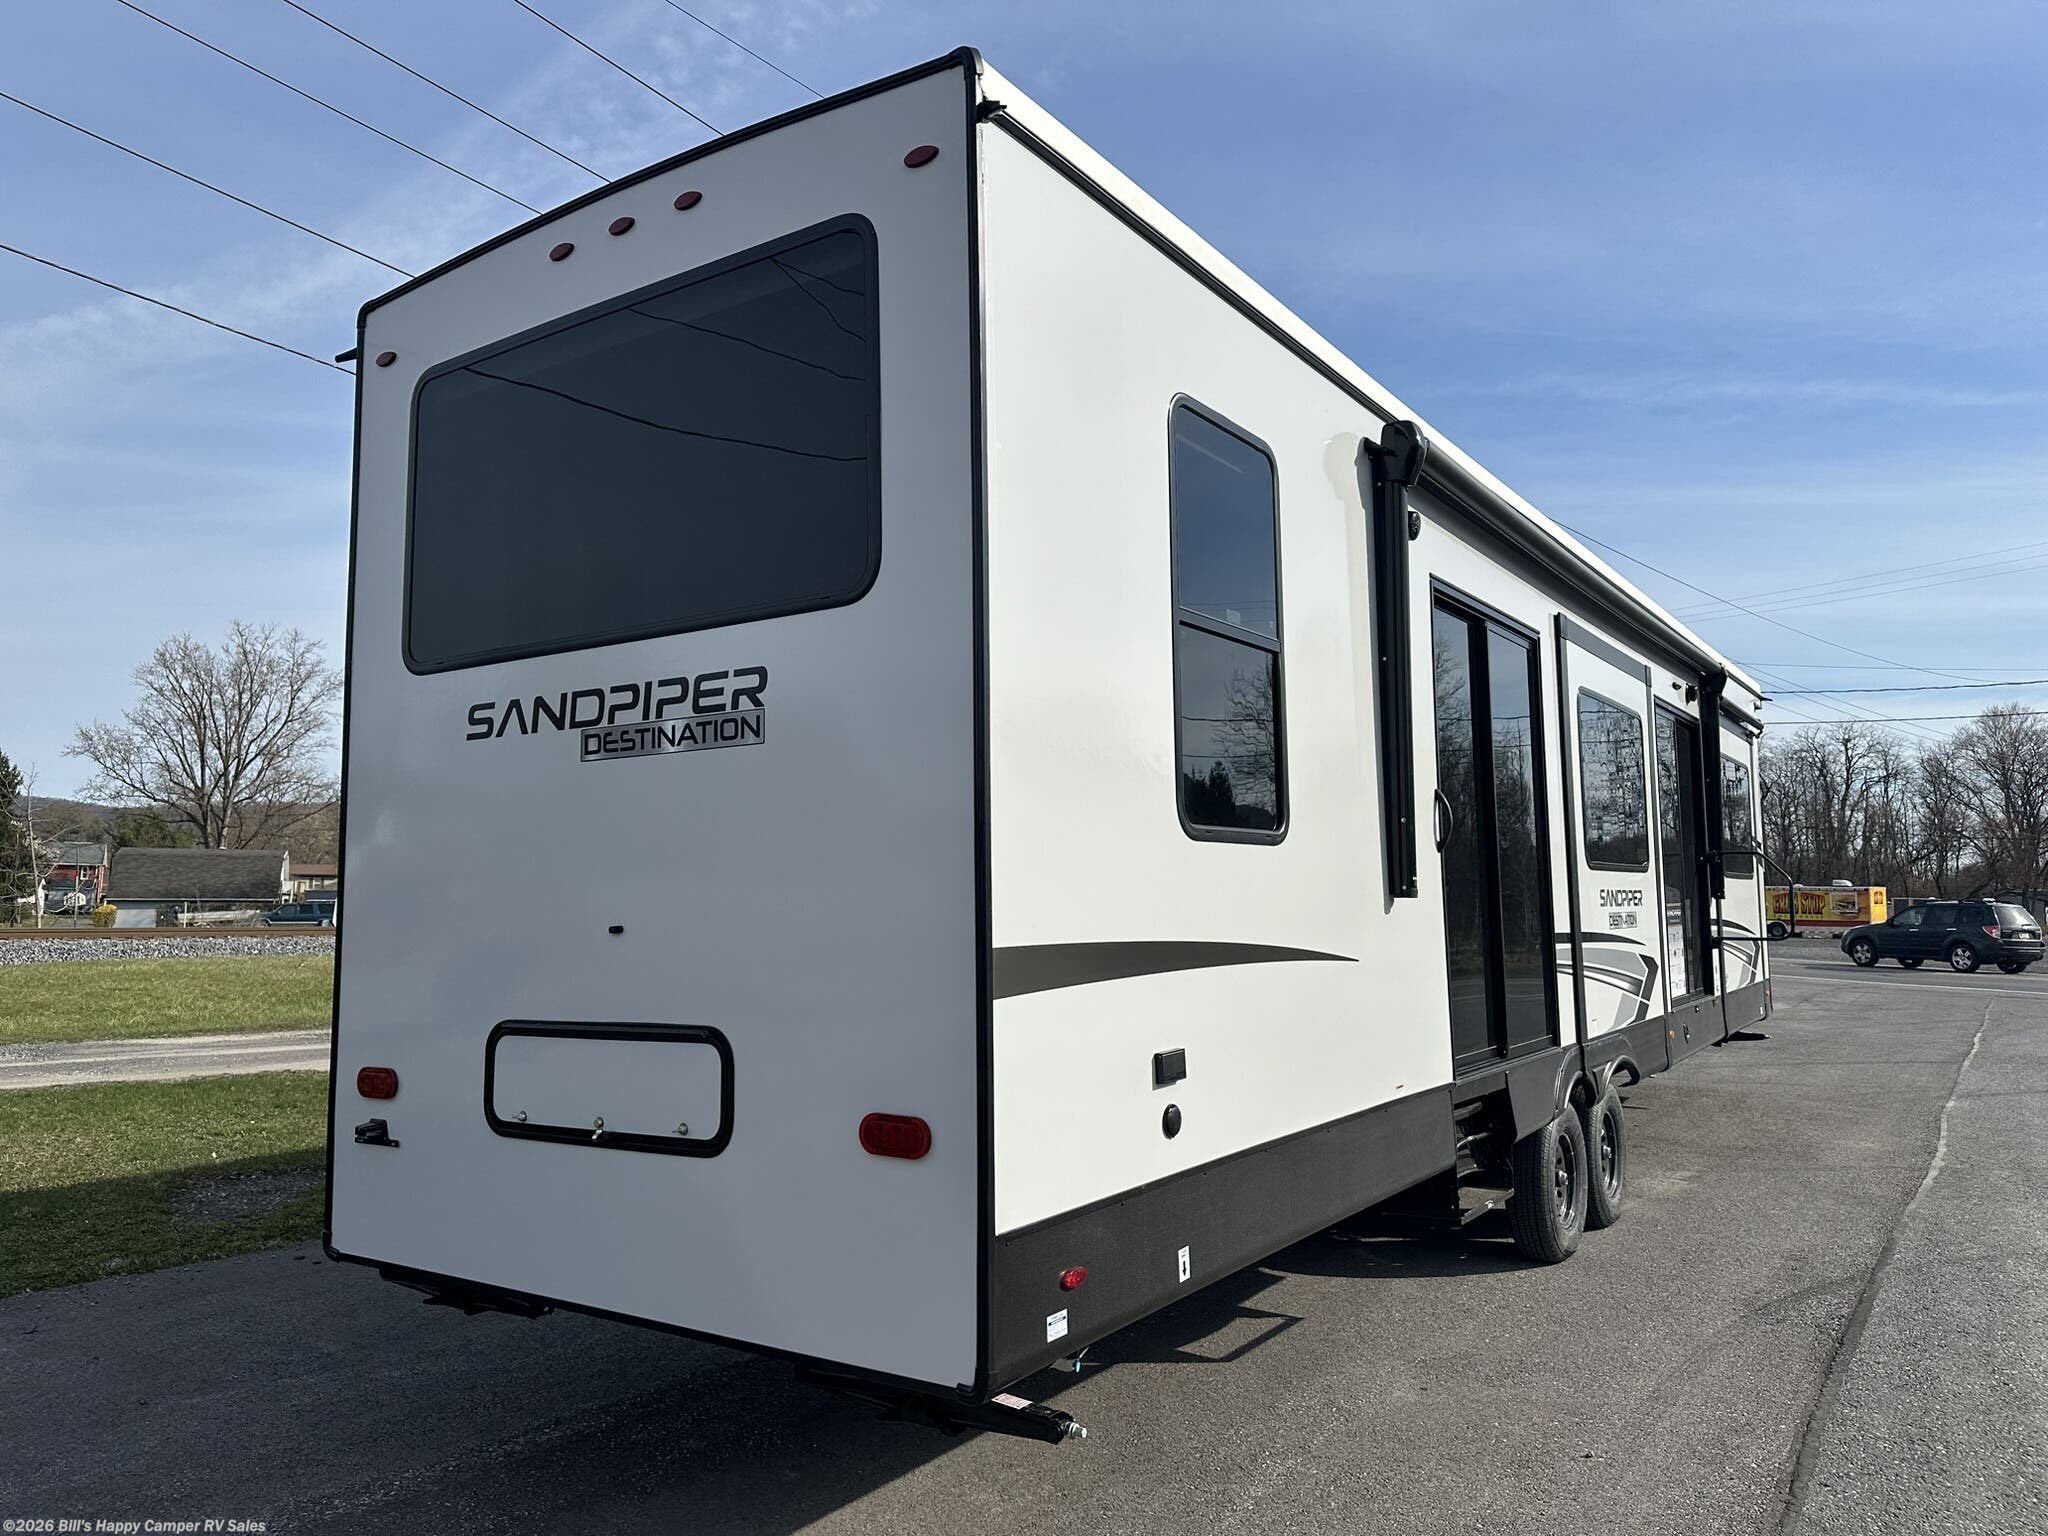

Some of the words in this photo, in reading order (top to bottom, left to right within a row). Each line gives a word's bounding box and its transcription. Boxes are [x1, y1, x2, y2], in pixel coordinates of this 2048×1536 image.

[466, 666, 768, 740] SANDPIPER
[584, 714, 761, 755] DESTINATION
[1600, 889, 1643, 907] SANDPIPER
